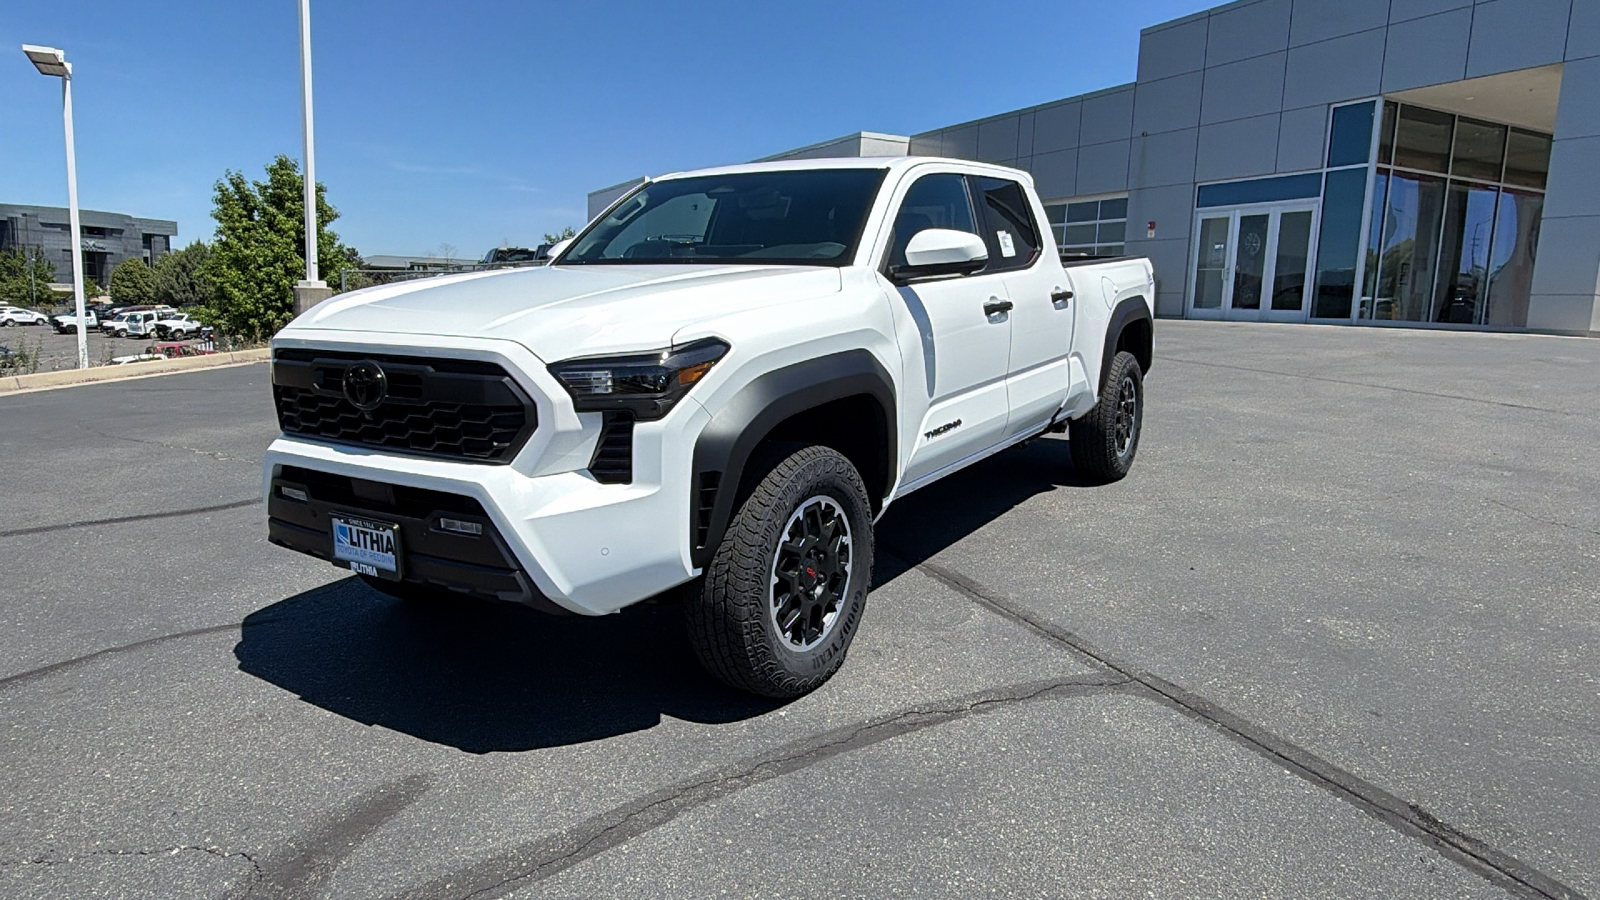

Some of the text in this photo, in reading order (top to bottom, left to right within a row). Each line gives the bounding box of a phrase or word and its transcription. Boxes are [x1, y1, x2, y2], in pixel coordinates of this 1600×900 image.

[924, 418, 962, 441] TACOMA
[348, 526, 395, 555] LITHIA
[337, 544, 359, 557] TOYOTA
[360, 549, 368, 558] OF
[356, 562, 379, 577] LITHIA
